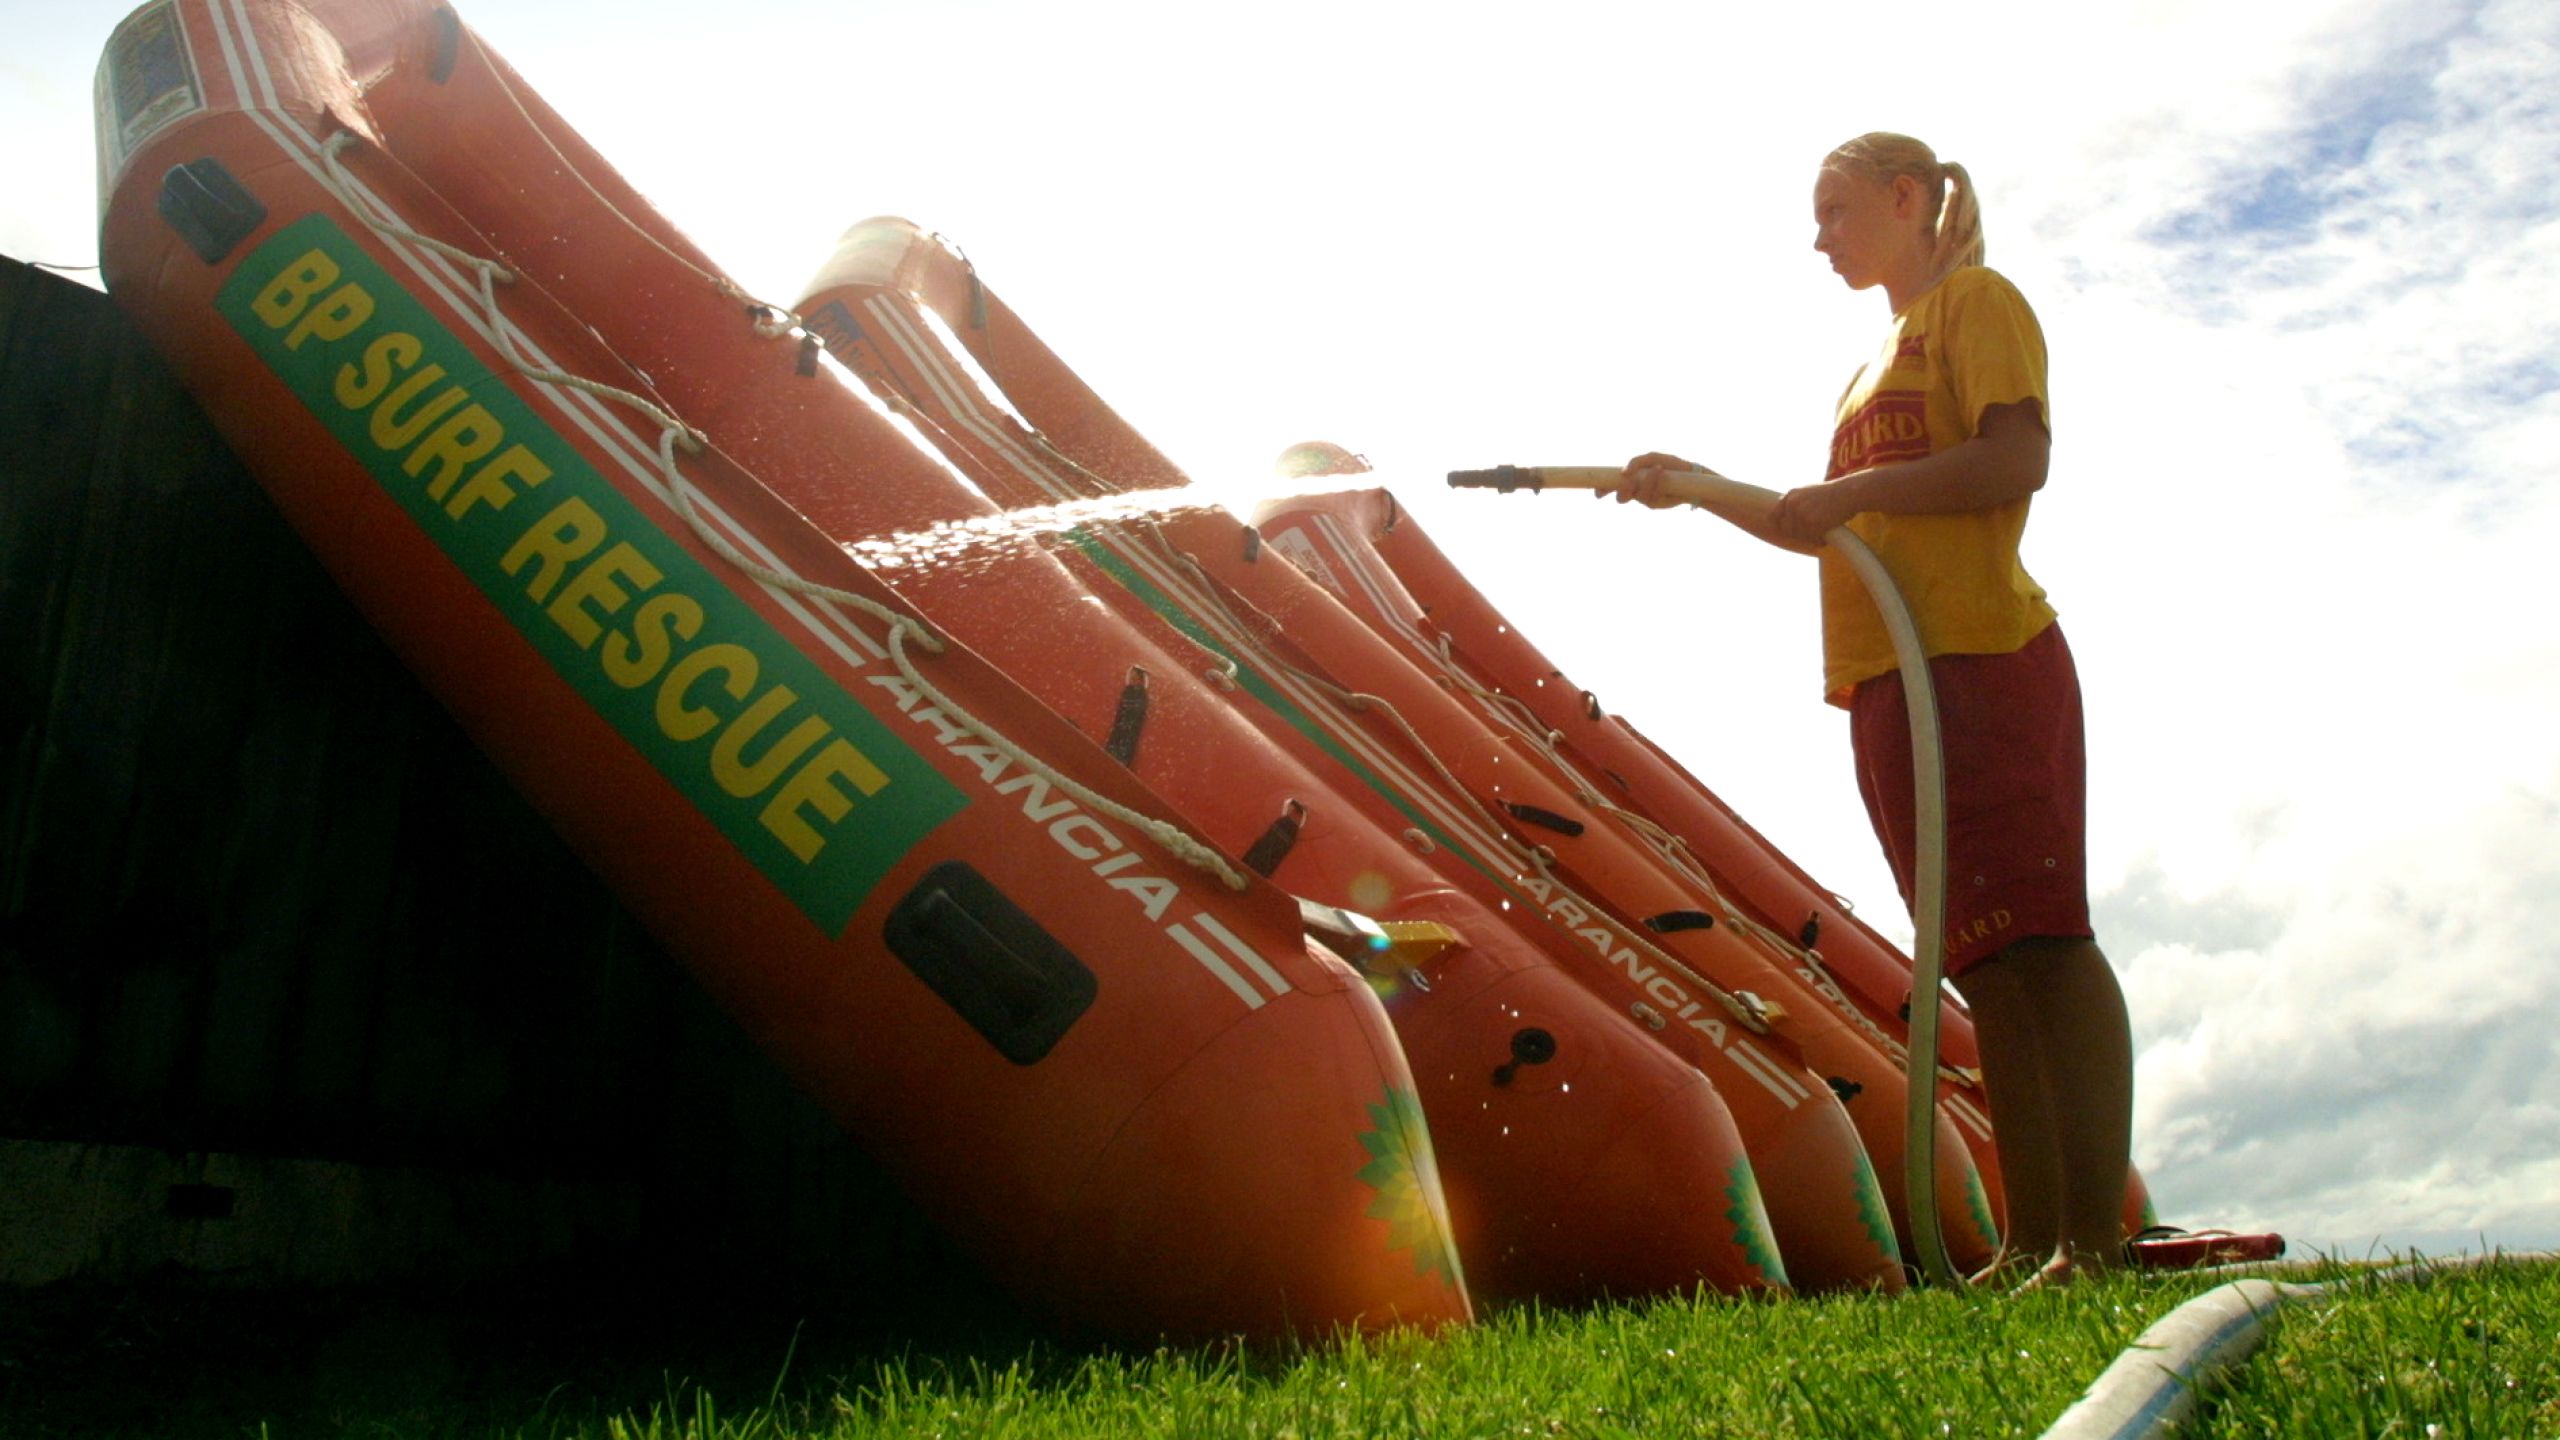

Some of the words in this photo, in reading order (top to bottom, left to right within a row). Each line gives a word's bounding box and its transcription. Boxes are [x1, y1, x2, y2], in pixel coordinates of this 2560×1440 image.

[252, 248, 374, 351] BP
[335, 332, 553, 521] SURF
[500, 496, 891, 864] RESCUE
[865, 675, 1179, 921] ARANCIA
[1516, 877, 1728, 1048] ARANCIA
